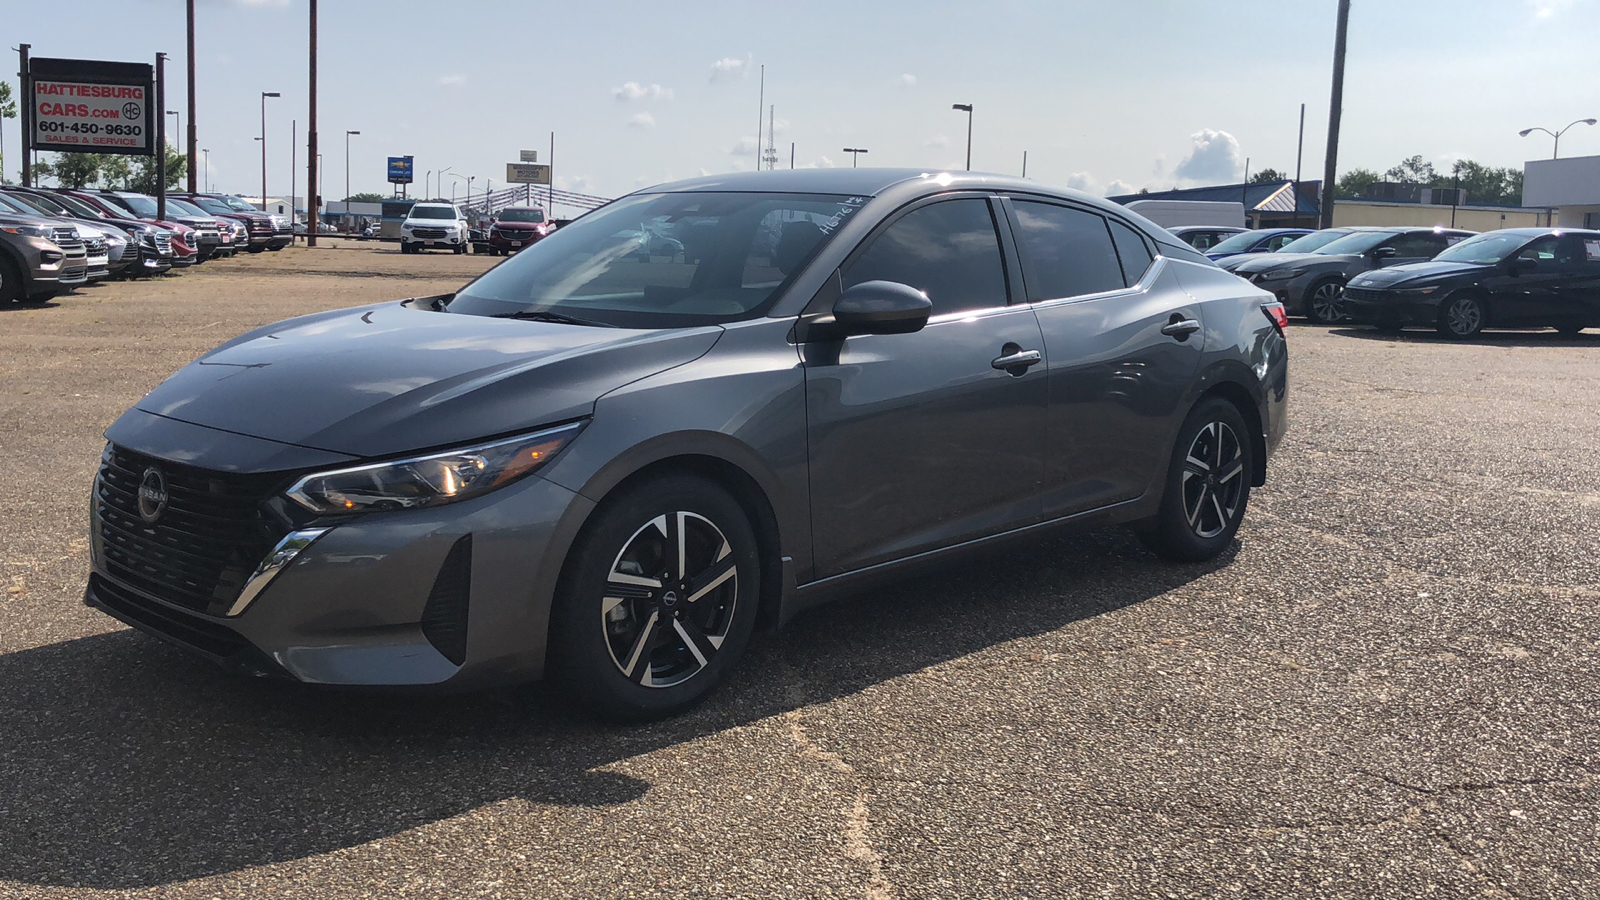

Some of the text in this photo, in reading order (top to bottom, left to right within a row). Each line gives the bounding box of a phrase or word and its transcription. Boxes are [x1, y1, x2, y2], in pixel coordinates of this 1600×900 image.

[36, 82, 142, 99] HATTIESBURG
[39, 120, 142, 136] 601-450-9630
[45, 135, 79, 144] SALES
[93, 138, 136, 146] SERVICE
[140, 487, 166, 501] SSAN
